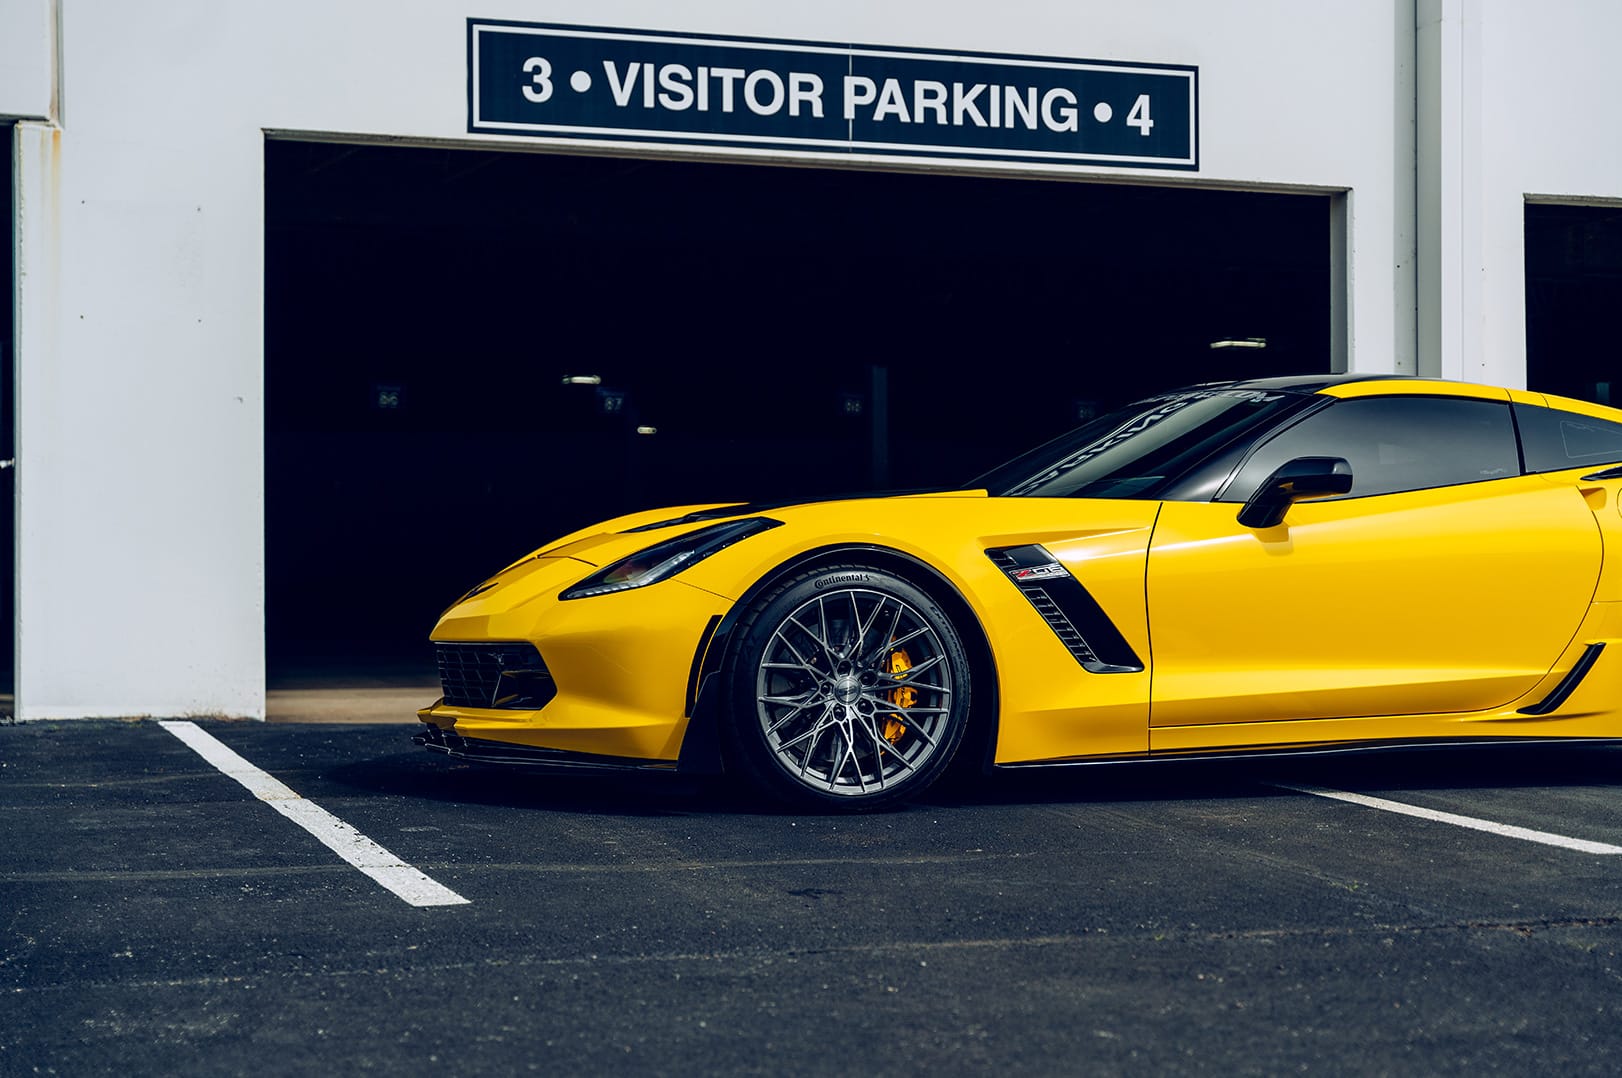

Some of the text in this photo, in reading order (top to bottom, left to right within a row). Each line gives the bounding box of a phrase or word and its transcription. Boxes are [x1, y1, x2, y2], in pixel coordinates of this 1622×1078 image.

[523, 57, 1154, 136] 3 VISITOR PARKING 4
[814, 573, 863, 589] Continental
